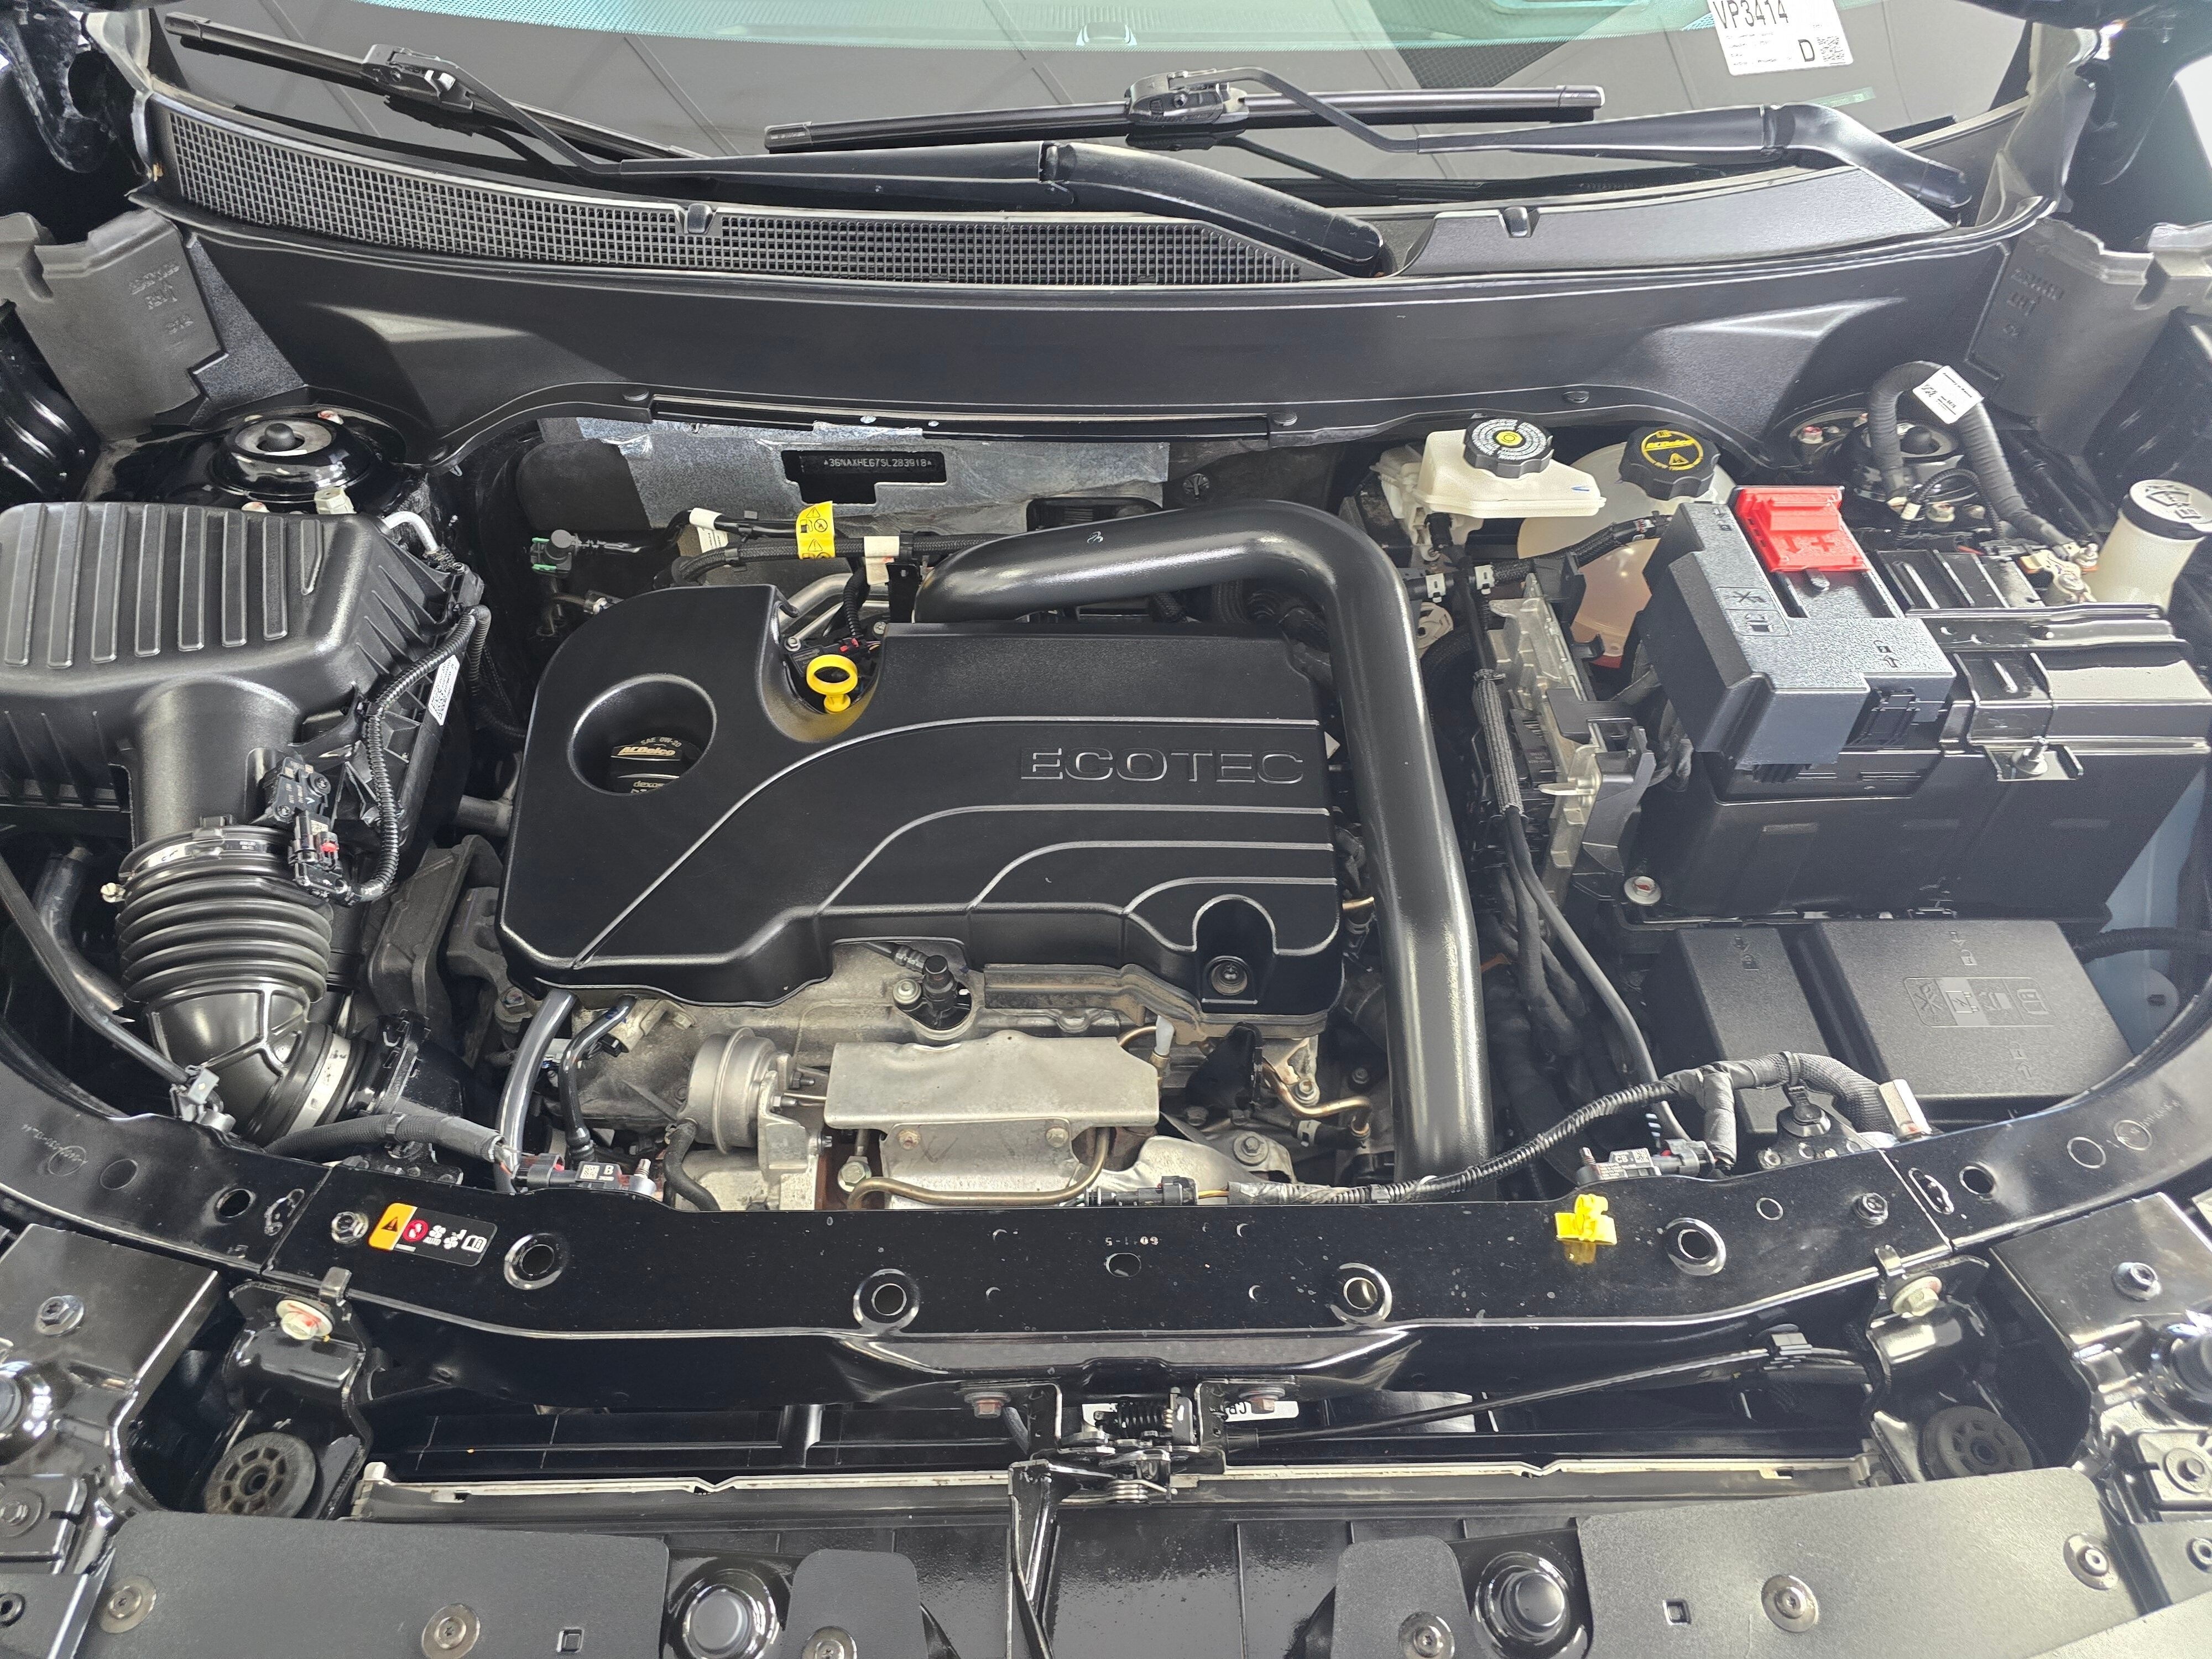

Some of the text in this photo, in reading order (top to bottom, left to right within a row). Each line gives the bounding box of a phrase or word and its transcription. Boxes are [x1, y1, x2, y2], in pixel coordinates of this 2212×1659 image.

[1713, 0, 1789, 29] VP3414
[1798, 39, 1815, 62] D
[617, 747, 676, 757] ACDelco
[640, 737, 656, 745] SAE
[1021, 747, 1304, 784] ECOTEC
